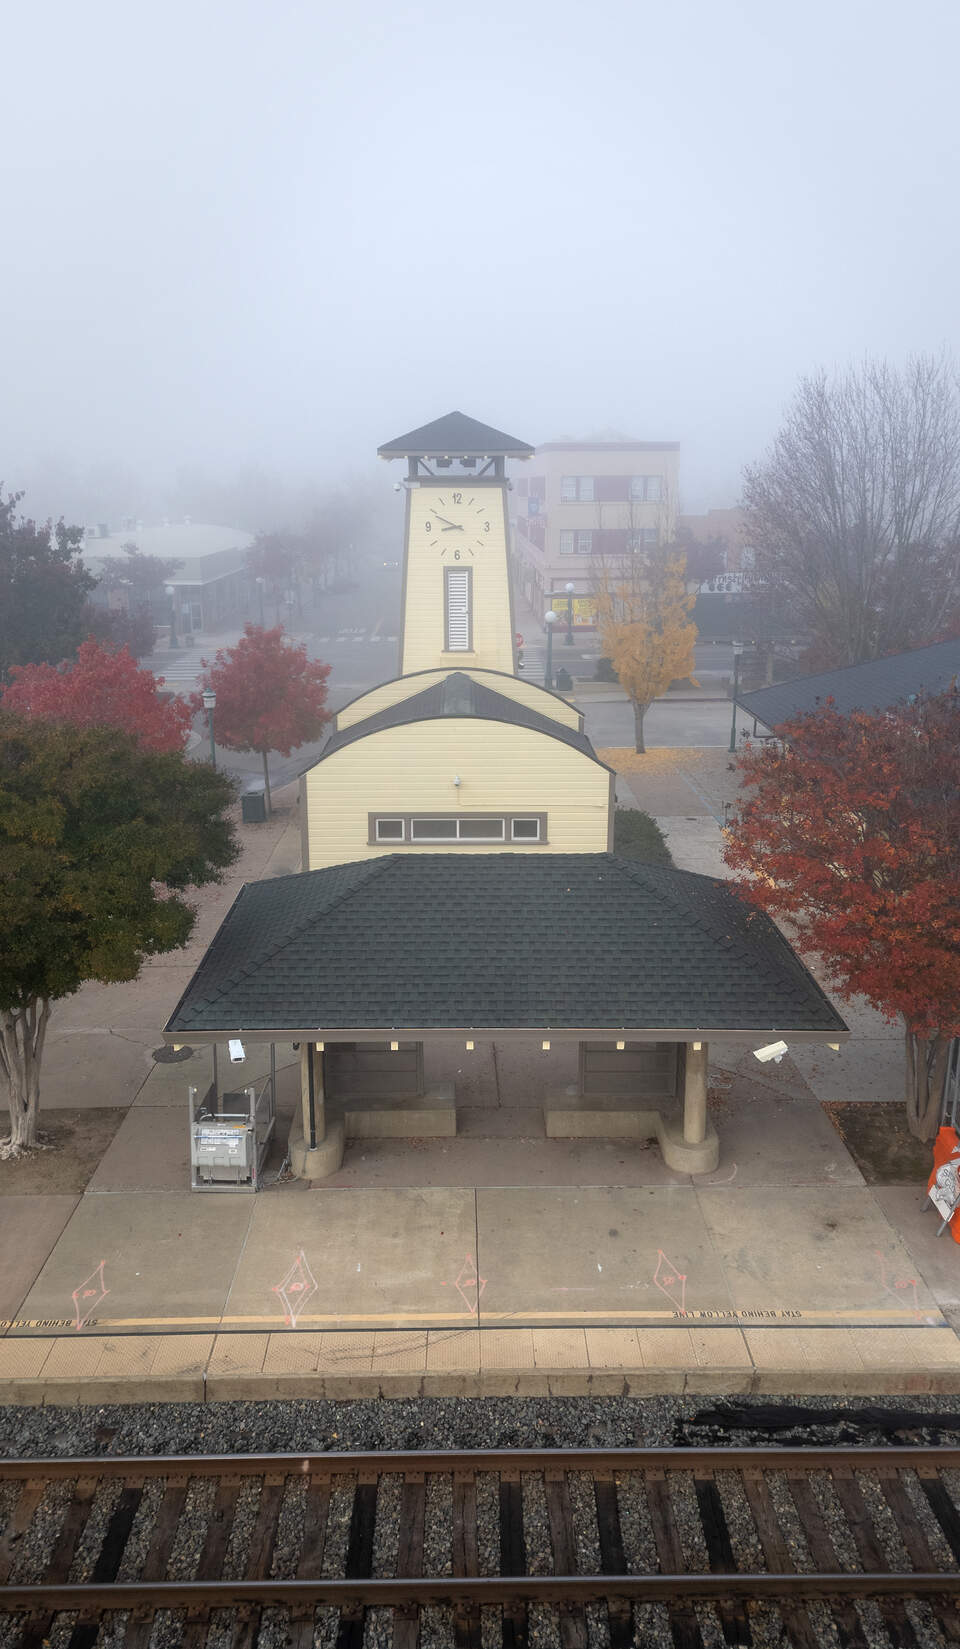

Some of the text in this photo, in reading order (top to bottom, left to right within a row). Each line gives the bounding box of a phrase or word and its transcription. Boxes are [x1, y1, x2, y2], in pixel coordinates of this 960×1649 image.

[452, 493, 462, 504] 12
[425, 521, 431, 532] 9
[484, 521, 490, 532] 3
[454, 550, 460, 560] 6
[672, 1311, 695, 1319] LINE
[36, 1320, 73, 1328] BEHIND
